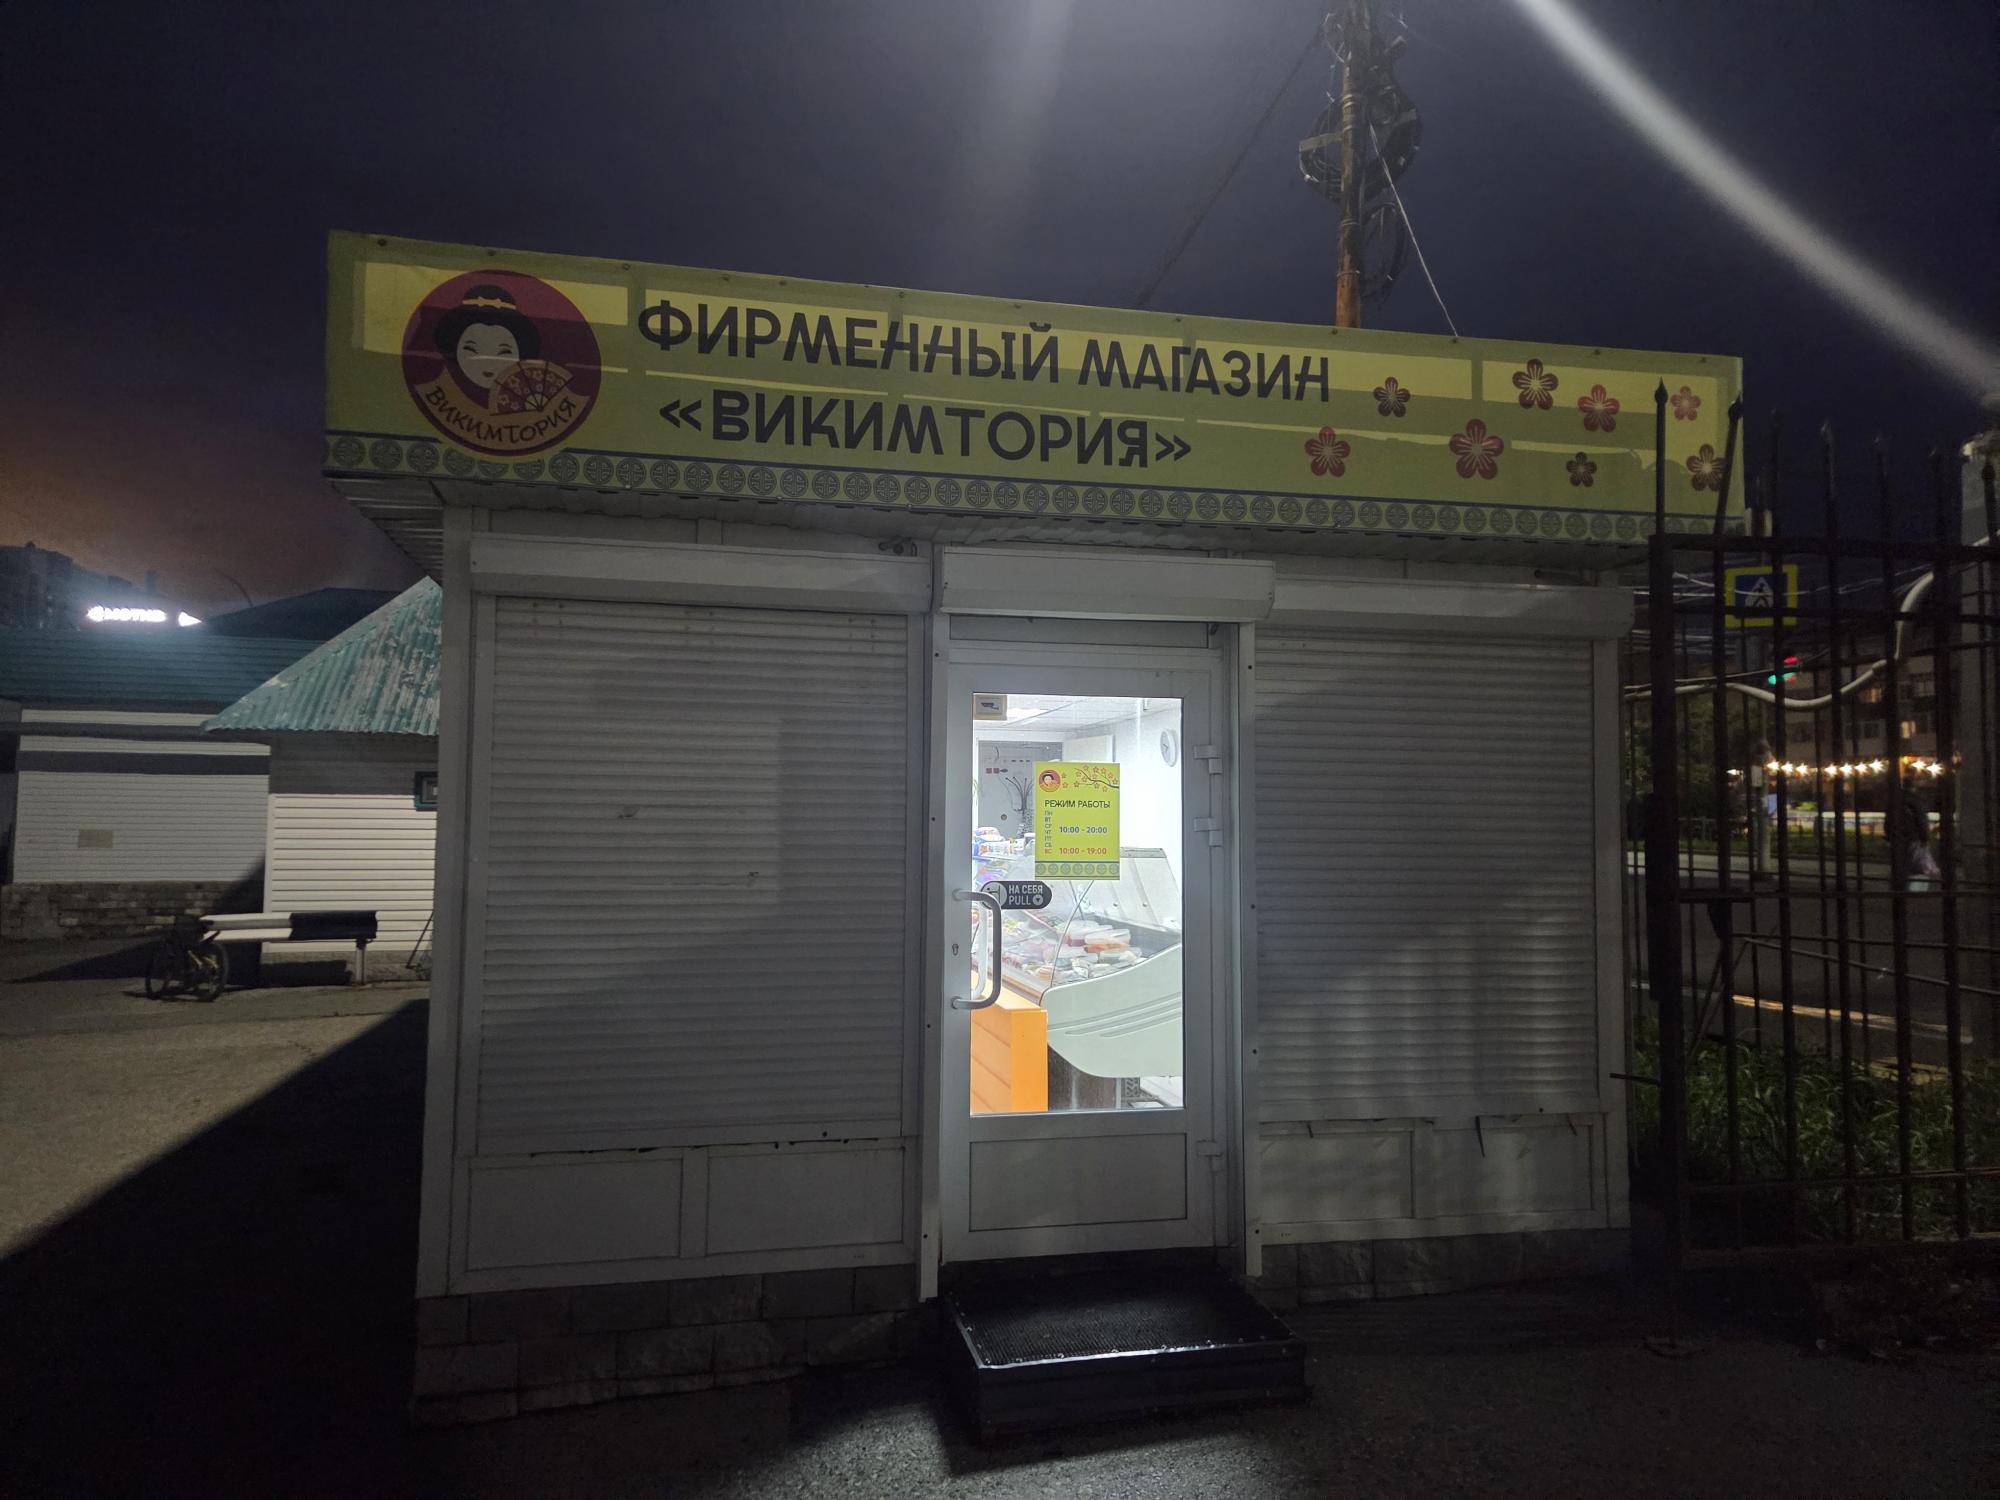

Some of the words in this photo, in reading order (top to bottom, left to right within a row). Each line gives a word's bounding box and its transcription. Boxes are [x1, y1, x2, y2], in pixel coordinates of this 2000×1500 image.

[638, 299, 1059, 384] ФИРМЕННЫЙ
[1078, 339, 1329, 402] МАГАЗИН
[659, 389, 1192, 468] «ВИКИМТОРИЯ»
[1044, 800, 1076, 808] РЕЖИМ
[1077, 800, 1111, 809] РАБОТЫ
[1086, 826, 1108, 834] 20:00
[1059, 847, 1080, 855] 10:00
[1087, 847, 1107, 855] 19:00
[1008, 884, 1021, 895] НА
[1022, 884, 1043, 895] СЕБЯ
[1008, 895, 1032, 906] PULL
